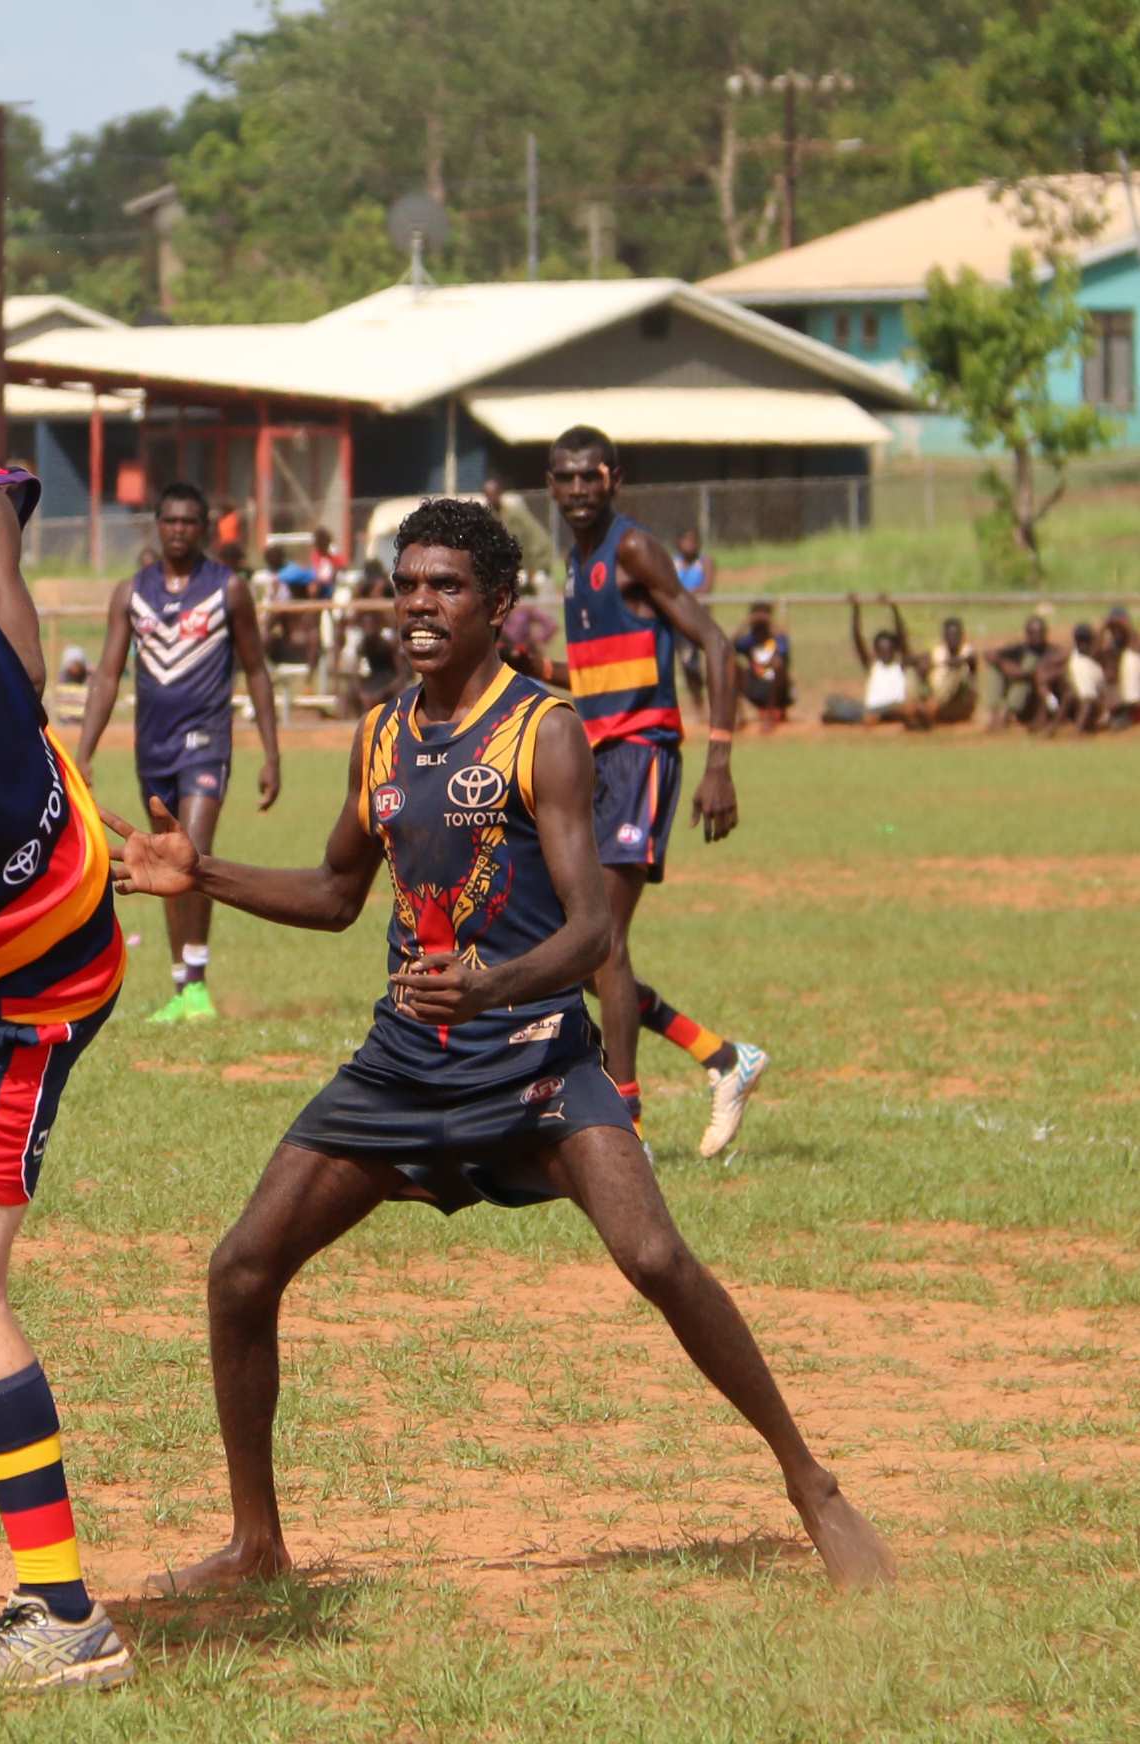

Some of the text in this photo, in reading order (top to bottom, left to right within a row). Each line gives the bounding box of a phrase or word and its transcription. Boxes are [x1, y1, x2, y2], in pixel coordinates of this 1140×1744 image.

[415, 752, 448, 767] BLK
[375, 793, 400, 814] AFL
[443, 811, 509, 828] TOYOTA
